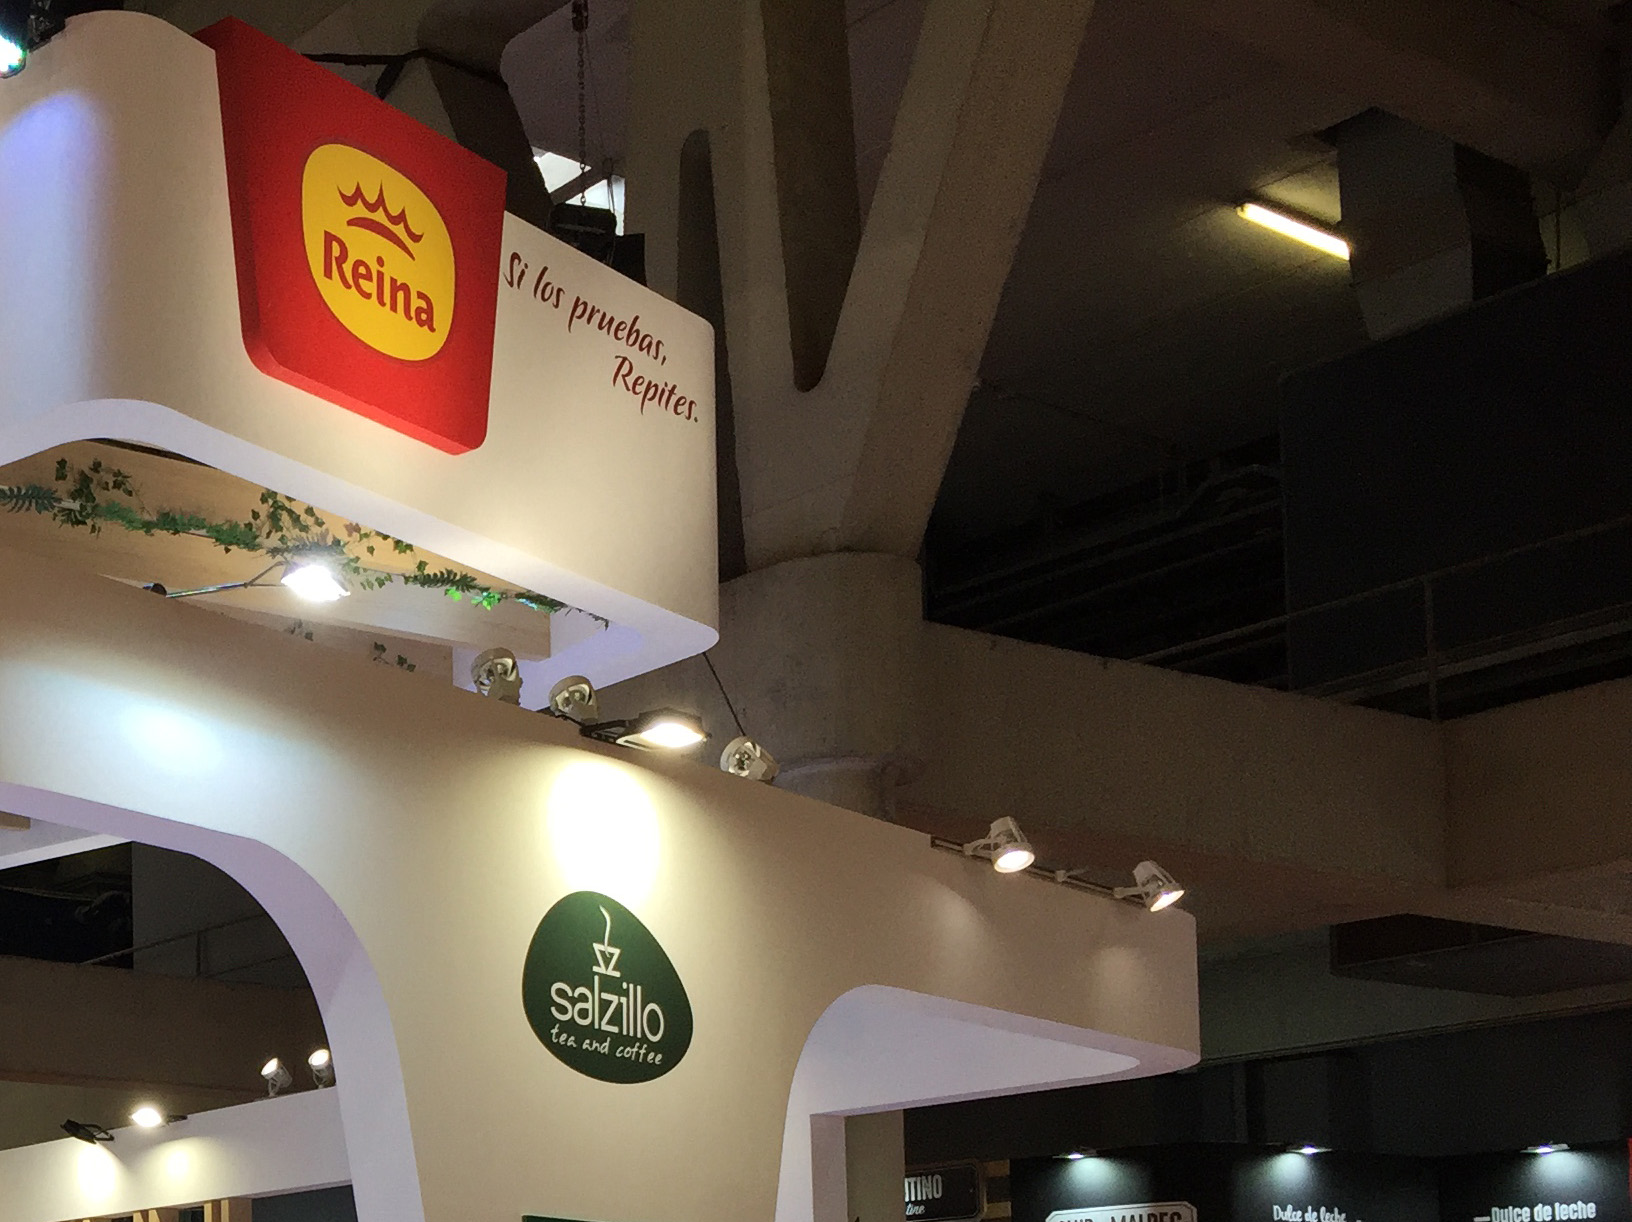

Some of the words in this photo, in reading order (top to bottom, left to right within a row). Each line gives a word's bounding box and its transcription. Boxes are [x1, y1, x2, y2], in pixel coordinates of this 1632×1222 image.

[323, 230, 436, 333] Reina
[503, 251, 528, 289] Si
[533, 266, 565, 309] los
[568, 295, 667, 366] pruebas,
[612, 355, 699, 423] Repites.
[550, 975, 665, 1043] salzillo
[550, 1024, 577, 1048] tea
[582, 1037, 611, 1055] and
[616, 1043, 663, 1065] coffee
[1273, 1204, 1302, 1222] Dulce
[1304, 1205, 1318, 1222] de
[1533, 1203, 1552, 1222] de
[1555, 1200, 1596, 1220] leche
